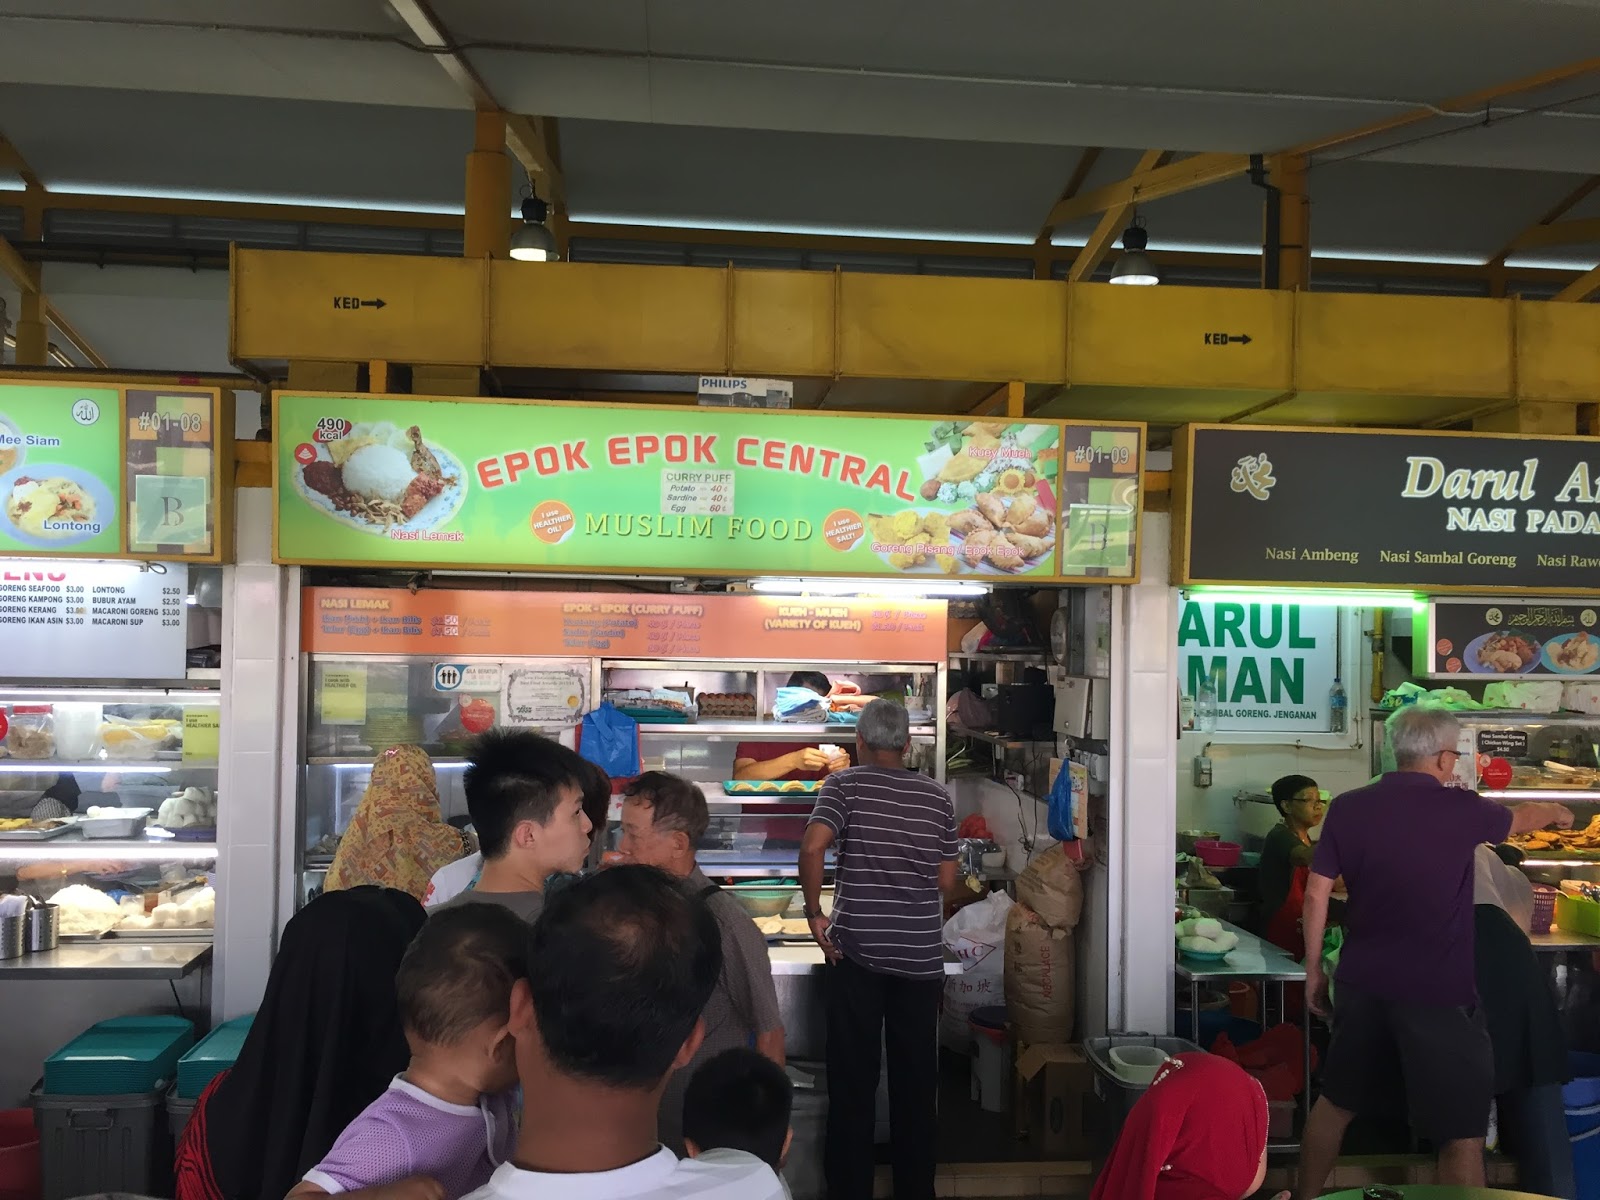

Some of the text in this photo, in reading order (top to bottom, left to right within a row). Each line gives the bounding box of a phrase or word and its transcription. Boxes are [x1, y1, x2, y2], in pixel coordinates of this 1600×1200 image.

[702, 378, 747, 389] PHILIPS
[138, 412, 202, 432] #01-08
[317, 418, 344, 430] 490
[26, 435, 60, 446] Siam
[319, 431, 342, 440] kcal
[1075, 445, 1130, 464] #01-09
[477, 434, 915, 501] EPOK EPOK CENTRAL
[666, 473, 731, 482] CURRY PUFF
[1401, 456, 1539, 501] Darul
[160, 496, 184, 526] B
[671, 504, 686, 512] Egg
[533, 514, 572, 529] HEALTHIER
[585, 512, 813, 540] MUSLIM FOOD
[1446, 507, 1516, 532] NASI
[44, 520, 101, 533] Lontong
[826, 522, 862, 538] HEALTHIER
[391, 530, 464, 541] Nasi Lemak
[871, 542, 913, 554] Goreng
[916, 543, 954, 555] Pisang
[965, 545, 992, 556] Epok
[996, 546, 1025, 556] Epok
[1265, 547, 1360, 564] Nasi Ambeng
[1380, 550, 1517, 568] Nasi Sambal Goreng
[1537, 554, 1567, 567] Nasi
[162, 587, 180, 595] $2.50
[92, 607, 128, 615] MACARONI
[321, 599, 390, 610] NASI LEMAK
[563, 604, 592, 613] EPOK
[600, 604, 630, 614] EPOK
[631, 604, 669, 616] (CURRY
[672, 605, 704, 617] PUFF)
[812, 619, 828, 629] OF
[1188, 655, 1304, 704] MAN
[1236, 709, 1271, 718] GORENG.
[1273, 710, 1317, 719] JENGANAN
